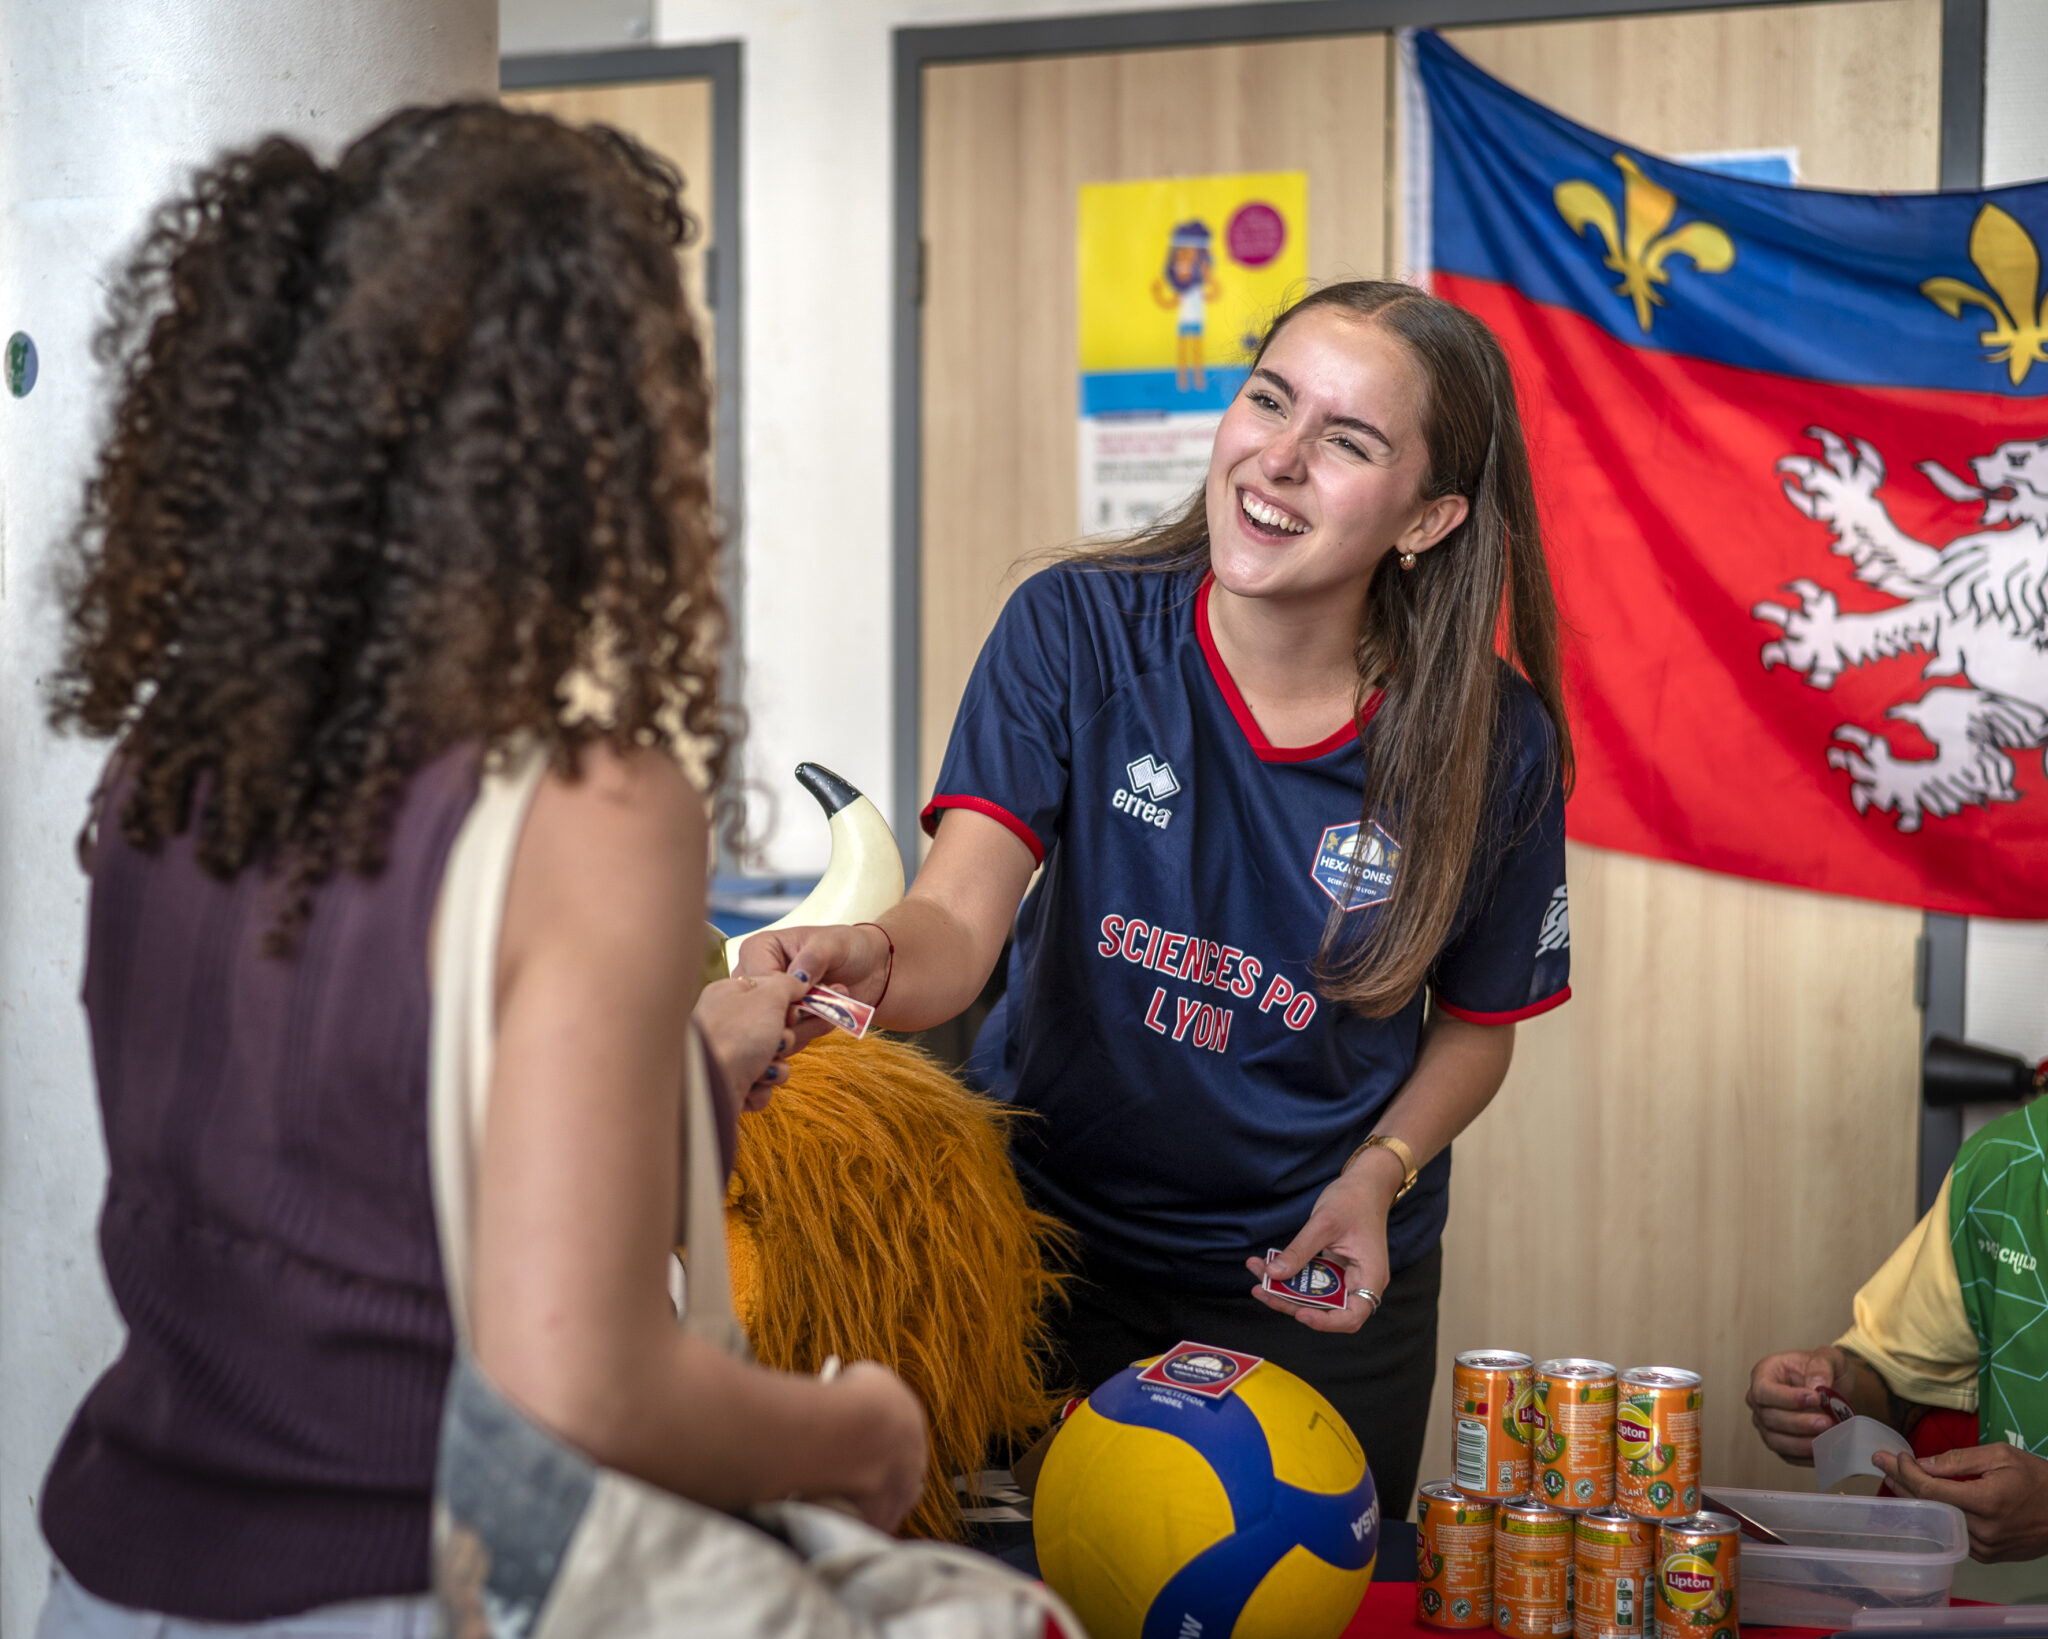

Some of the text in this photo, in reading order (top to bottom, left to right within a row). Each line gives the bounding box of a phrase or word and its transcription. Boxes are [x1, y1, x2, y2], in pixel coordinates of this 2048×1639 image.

[1098, 914, 1317, 1031] SCIENCES PO
[1144, 987, 1233, 1053] LYON
[1141, 1384, 1206, 1407] COMPETITION
[1150, 1393, 1183, 1409] MODEL
[1617, 1421, 1647, 1440] Lipton
[1669, 1573, 1711, 1590] Lipton
